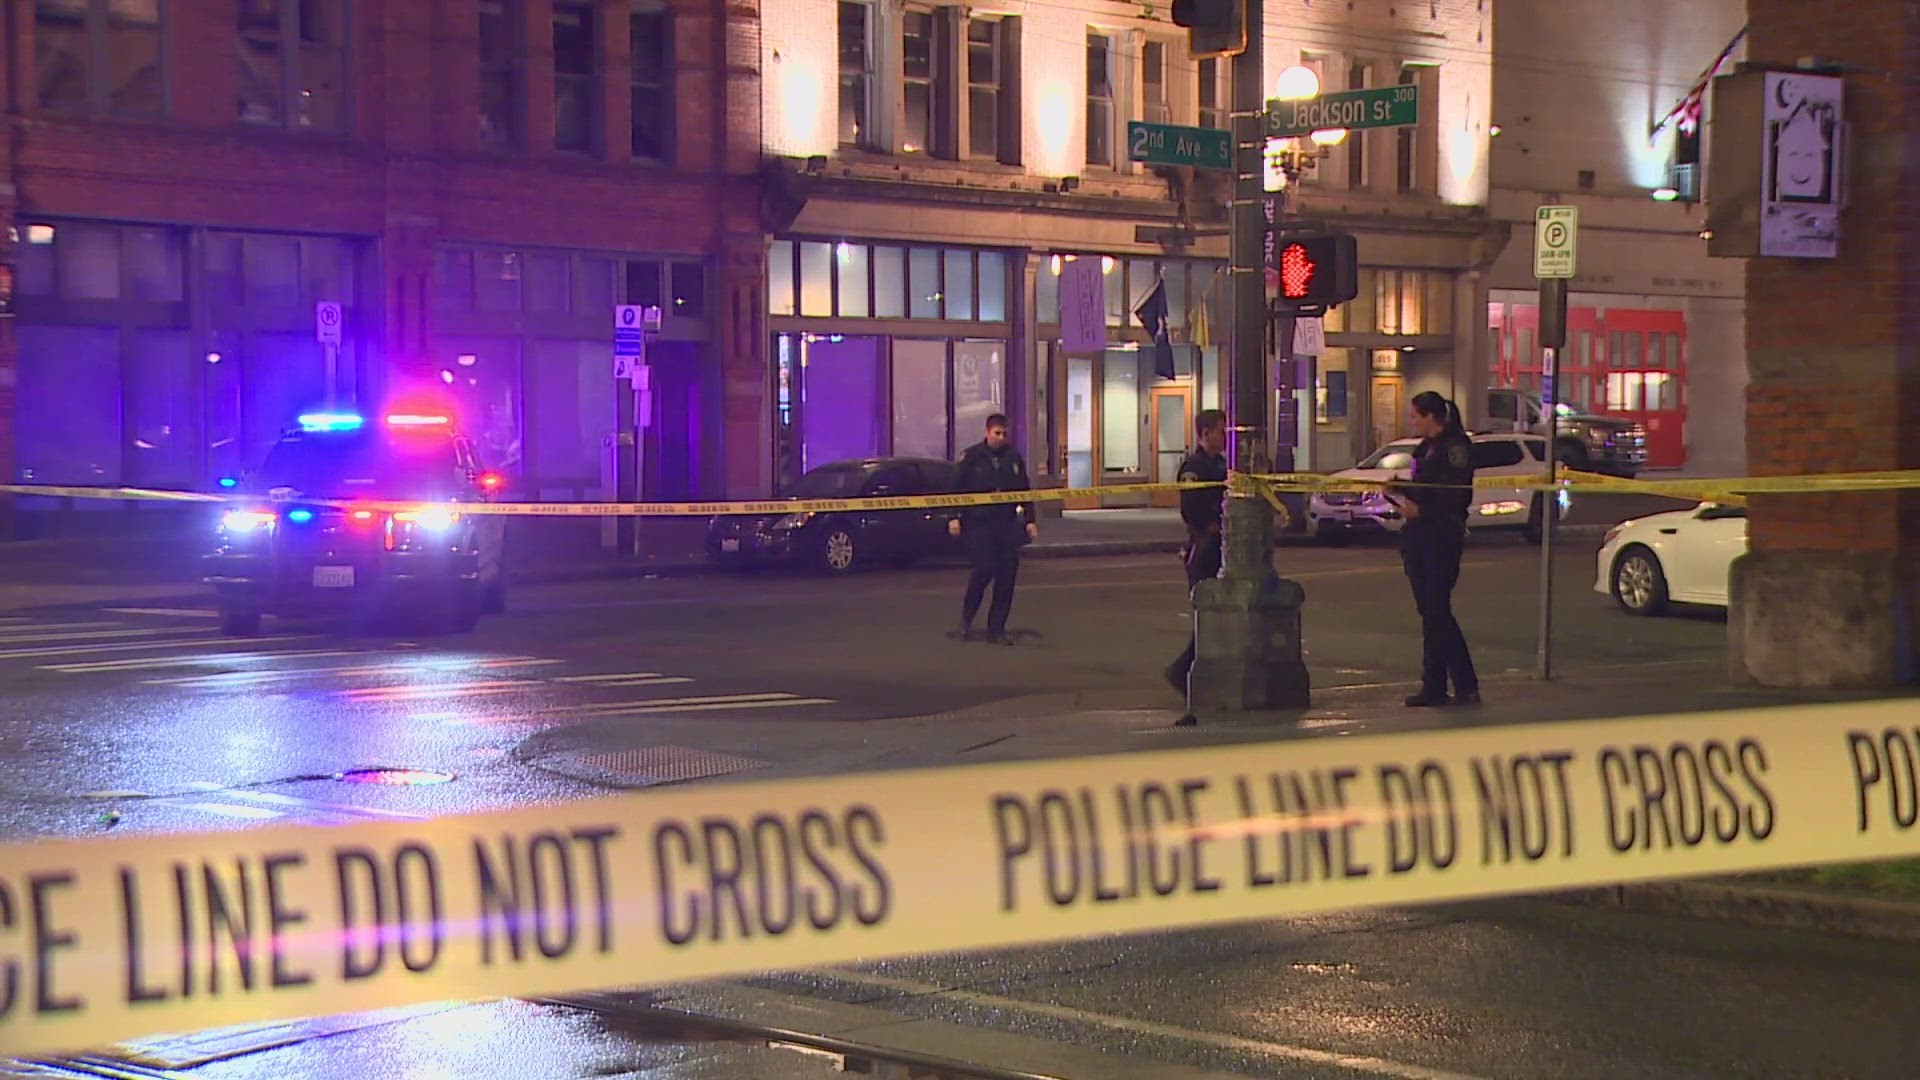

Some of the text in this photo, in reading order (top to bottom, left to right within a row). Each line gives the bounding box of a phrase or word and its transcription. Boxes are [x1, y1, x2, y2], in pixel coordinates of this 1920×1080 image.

[1287, 98, 1365, 129] Jackson
[1373, 101, 1392, 120] St
[1394, 87, 1415, 102] 300
[1132, 127, 1229, 159] 2nd Ave S
[1847, 726, 1920, 831] PO
[990, 737, 1775, 912] POLICE LINE DO NOT CROSS
[118, 852, 313, 1006] LINE
[334, 841, 443, 980] DO
[473, 823, 621, 965] NOT
[652, 803, 893, 946] CROSS
